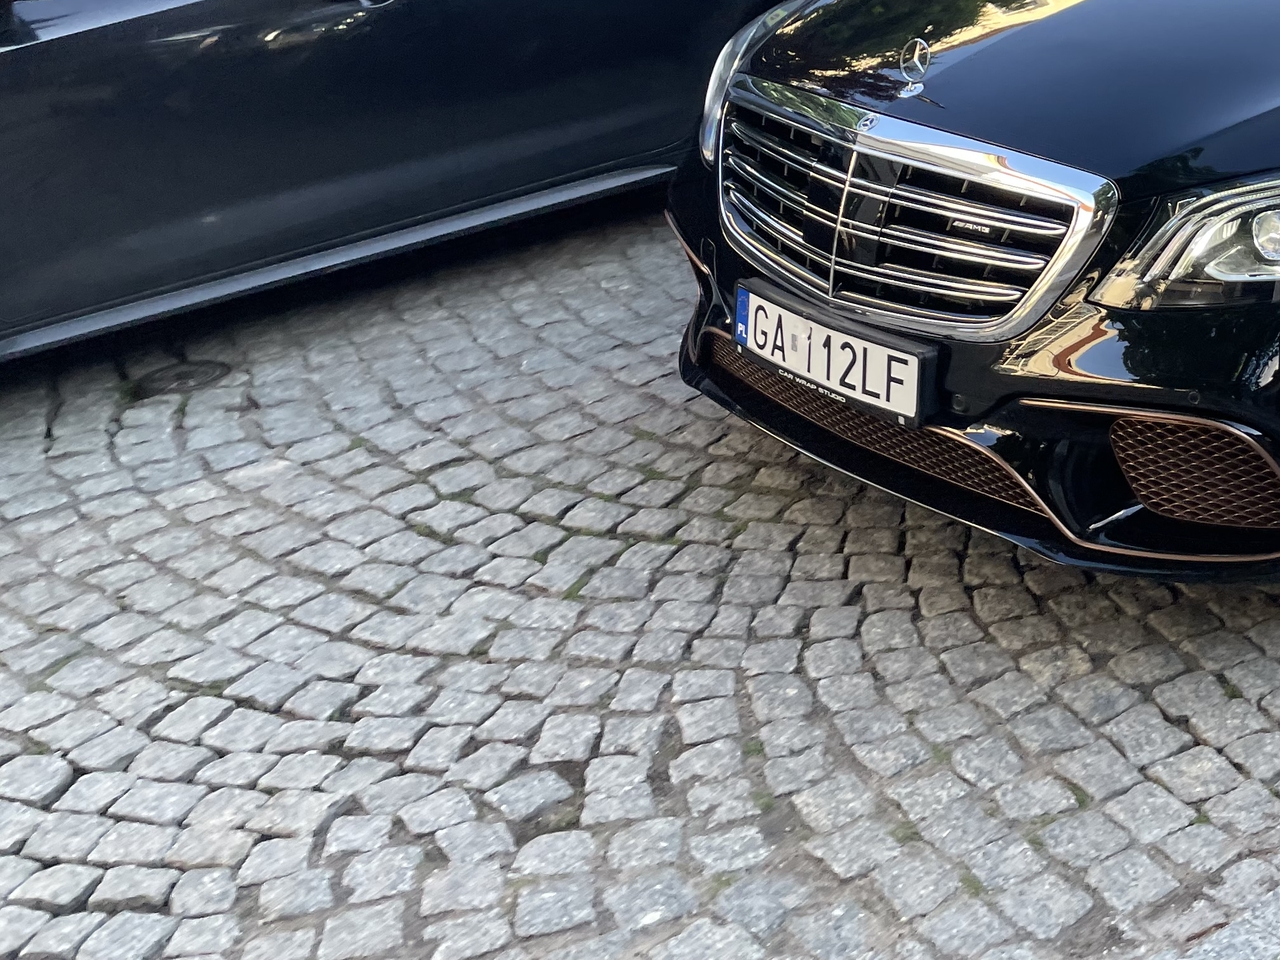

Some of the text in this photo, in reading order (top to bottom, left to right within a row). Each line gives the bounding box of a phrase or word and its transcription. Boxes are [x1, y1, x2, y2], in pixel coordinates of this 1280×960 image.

[738, 322, 747, 338] PL
[753, 304, 909, 403] GA 112LF
[778, 368, 846, 403] CAR WRAP STUDIO
